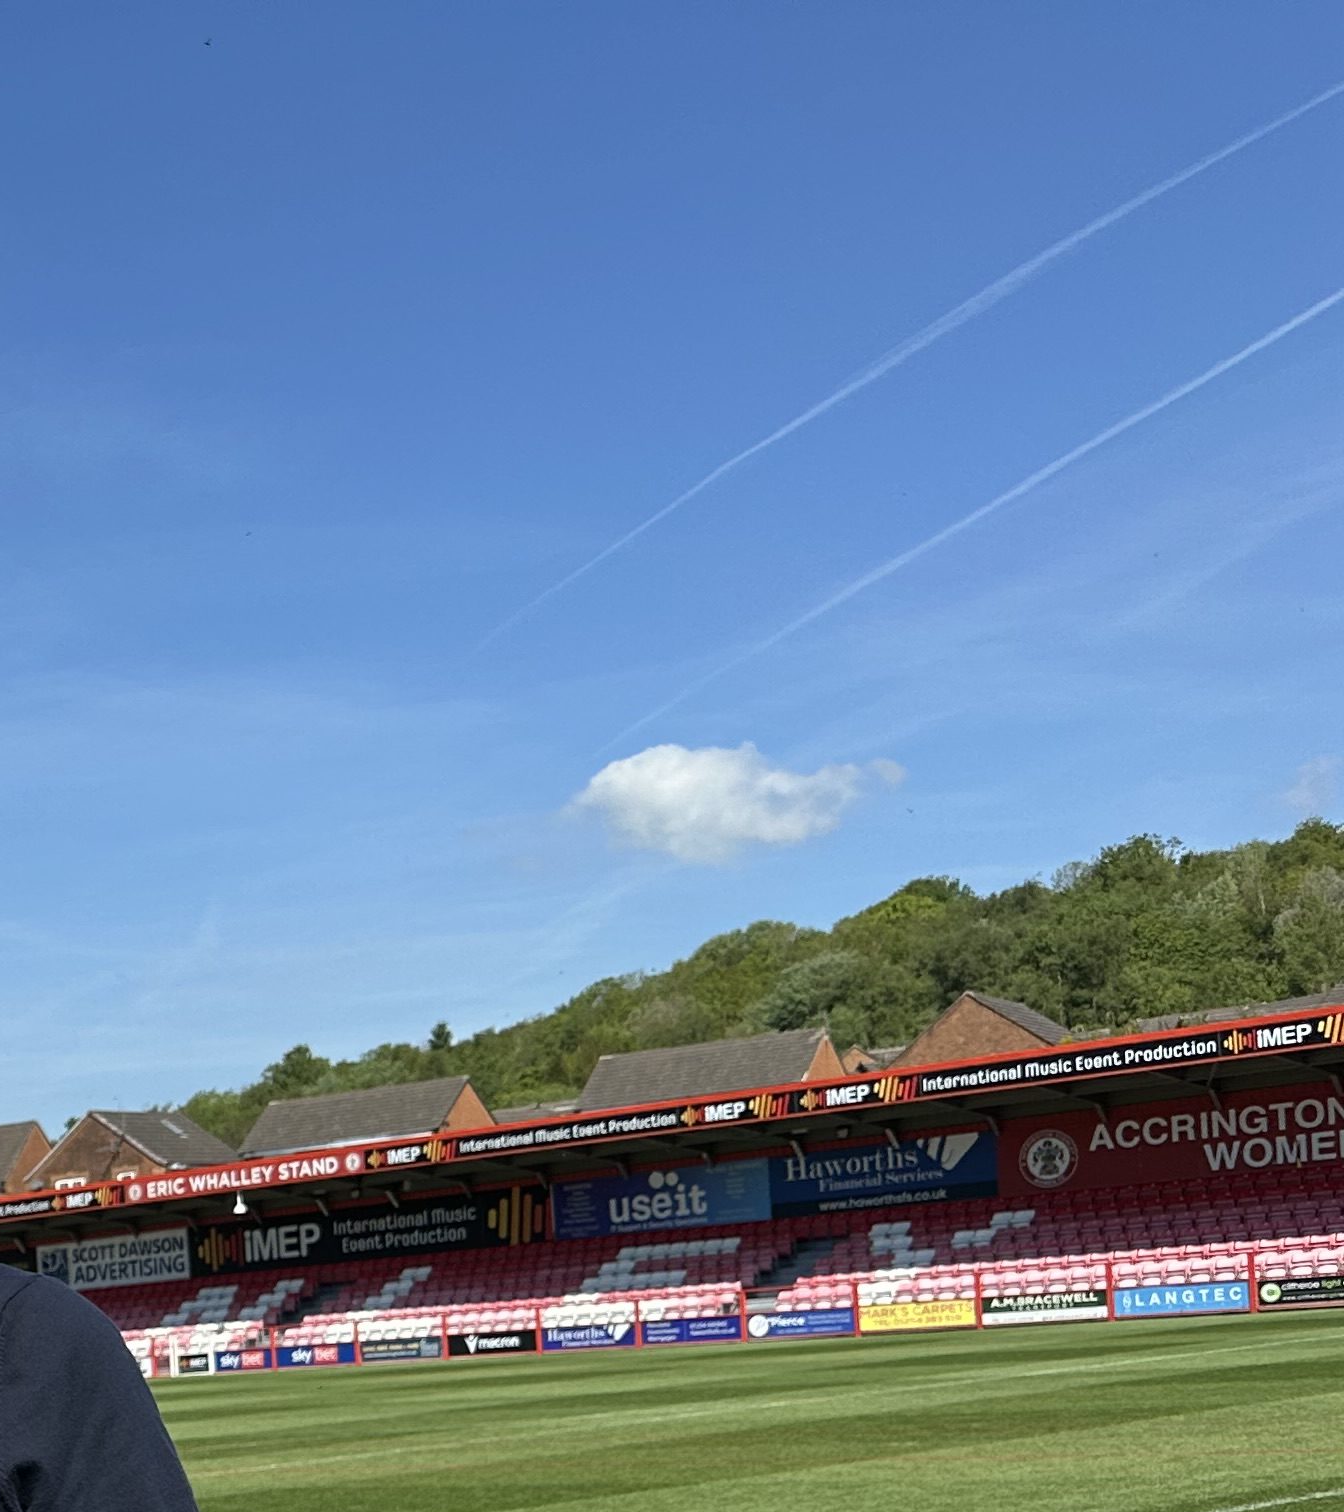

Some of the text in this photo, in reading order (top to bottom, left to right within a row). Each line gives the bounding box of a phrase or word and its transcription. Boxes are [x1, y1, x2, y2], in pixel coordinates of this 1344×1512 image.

[922, 1039, 1217, 1092] International Music Event Production
[459, 1111, 676, 1153] International Music Event Production
[1088, 1097, 1344, 1152] ACCRINGTON
[784, 1147, 919, 1182] Haworths
[1203, 1131, 1344, 1172] WOME
[146, 1156, 339, 1198] ERIC WHALLEY STAND
[818, 1168, 944, 1193] Financial Services
[609, 1183, 708, 1223] useit
[332, 1205, 477, 1236] International Music
[71, 1236, 184, 1264] SCOTT DAWSON
[341, 1226, 468, 1254] Event Production
[73, 1254, 186, 1284] ADVERTISING
[913, 1302, 974, 1316] CARPETS
[1135, 1286, 1243, 1307] LANGTEC
